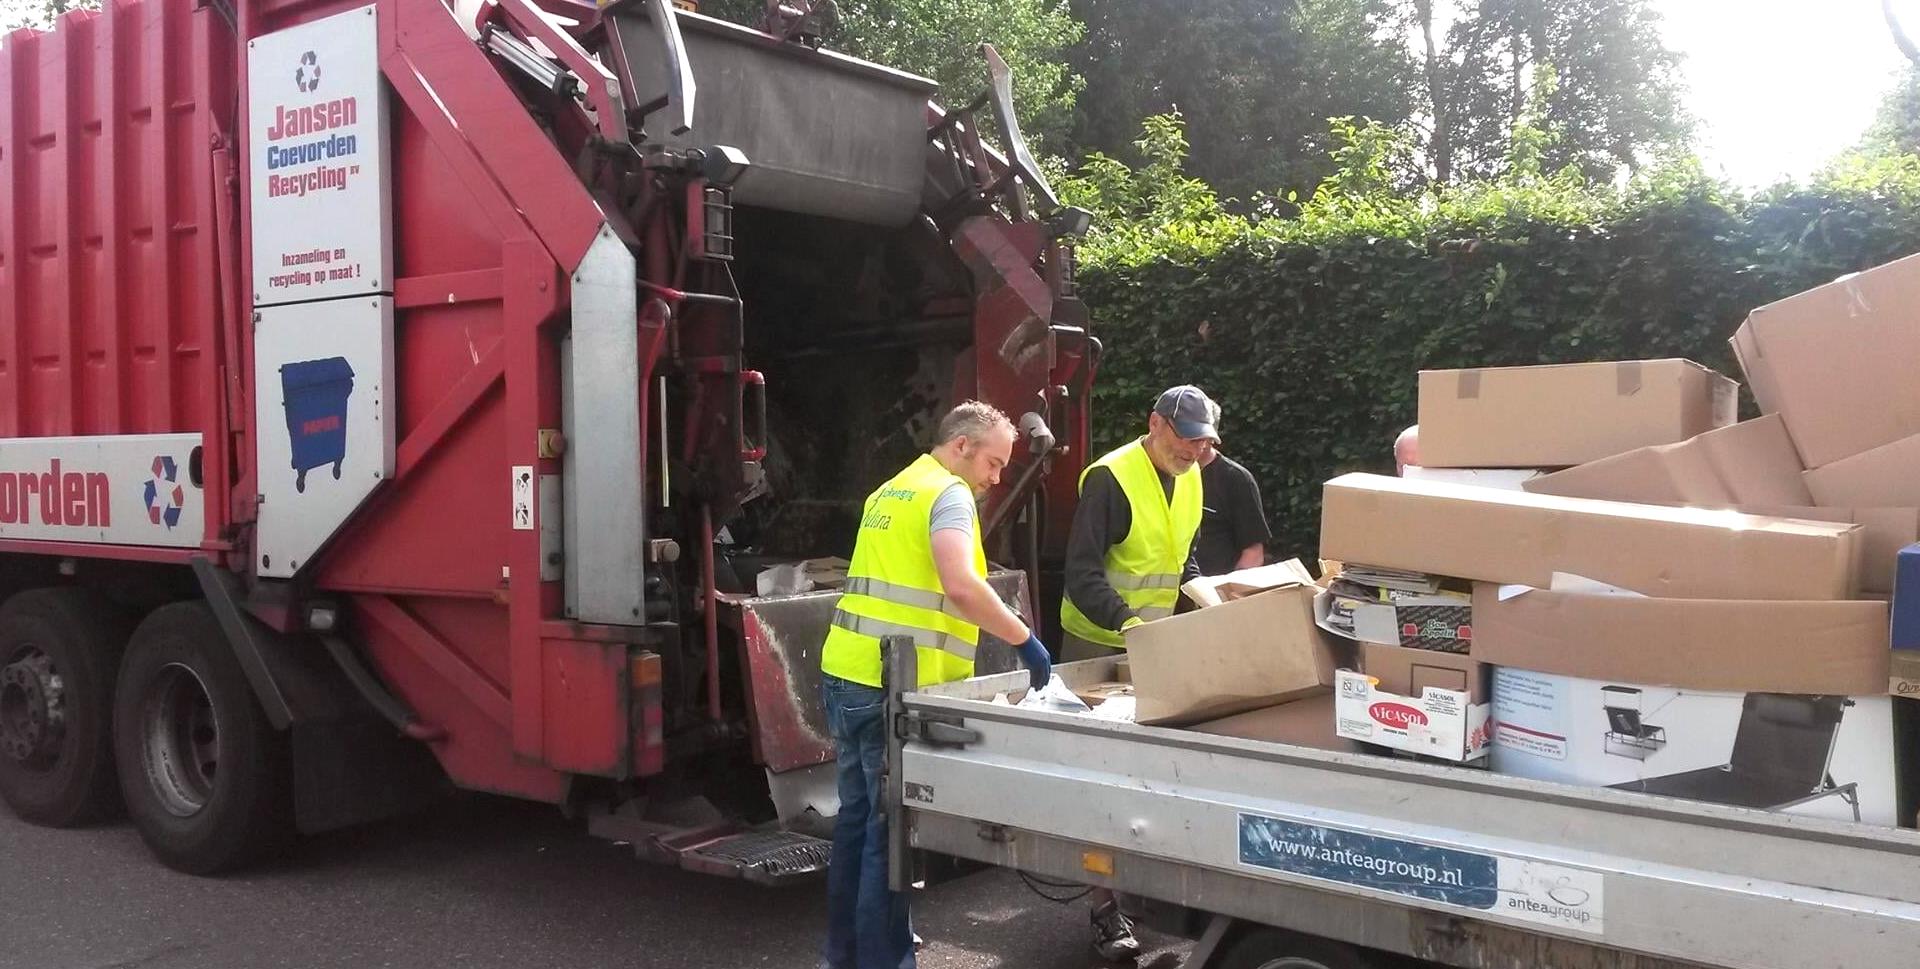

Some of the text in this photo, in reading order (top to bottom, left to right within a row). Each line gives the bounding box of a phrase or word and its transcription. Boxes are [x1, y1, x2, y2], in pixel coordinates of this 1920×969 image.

[267, 97, 356, 141] Jansen
[267, 134, 356, 170] Coevorden
[268, 166, 346, 198] Recycling
[281, 248, 346, 267] Inzameling en
[269, 271, 311, 288] recycling
[314, 270, 326, 284] op
[329, 264, 353, 281] maat
[0, 459, 110, 527] orden
[1268, 838, 1464, 886] www.anteagroup.nl
[1508, 898, 1591, 924] anteagroup
